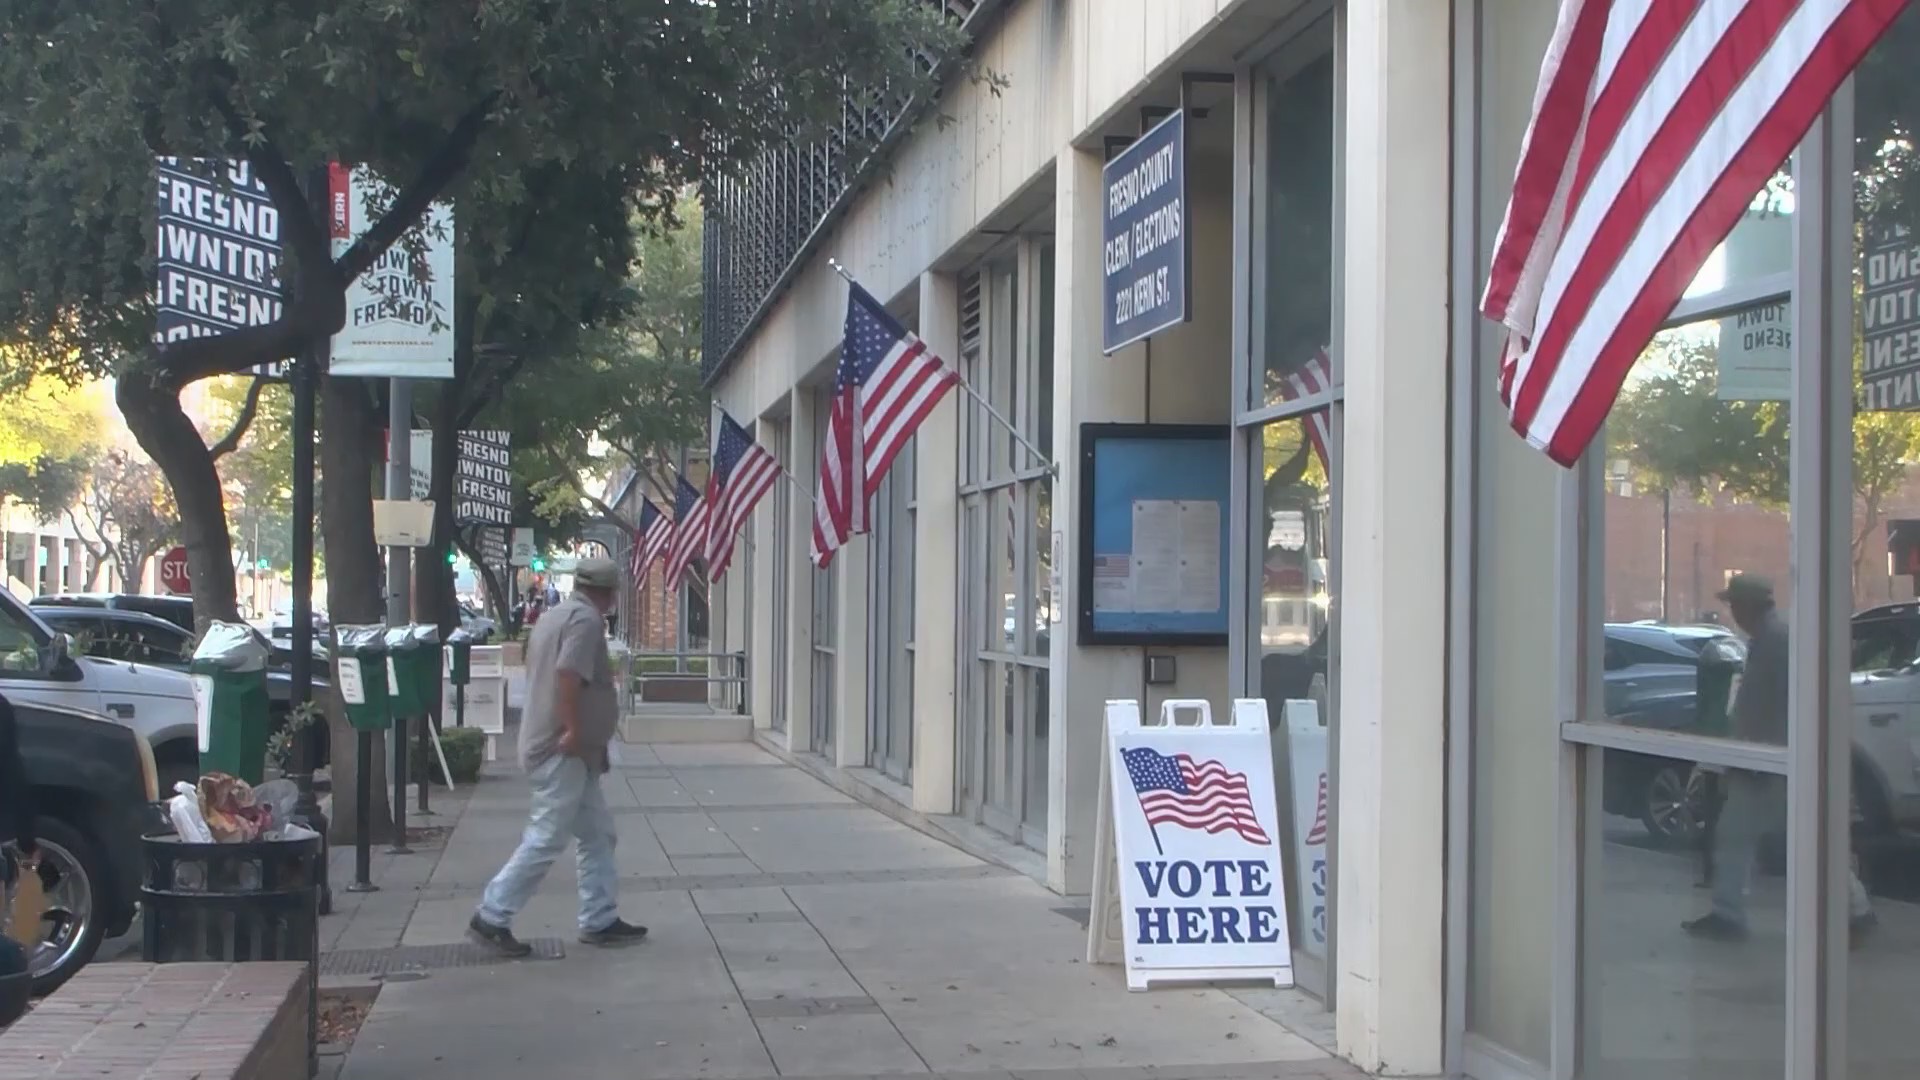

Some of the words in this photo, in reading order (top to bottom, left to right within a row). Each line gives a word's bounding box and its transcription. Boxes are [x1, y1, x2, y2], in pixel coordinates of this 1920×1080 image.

[1109, 167, 1139, 220] FRESNO
[1140, 141, 1174, 198] COUNTY
[1105, 230, 1130, 276] CLERK
[1136, 197, 1180, 260] ELECTIONS
[377, 275, 432, 302] TOWN
[1115, 291, 1133, 325] 2221
[1134, 273, 1156, 317] KERN
[354, 301, 425, 326] FRESO
[1134, 860, 1272, 898] VOTE
[1134, 906, 1280, 944] HERE
